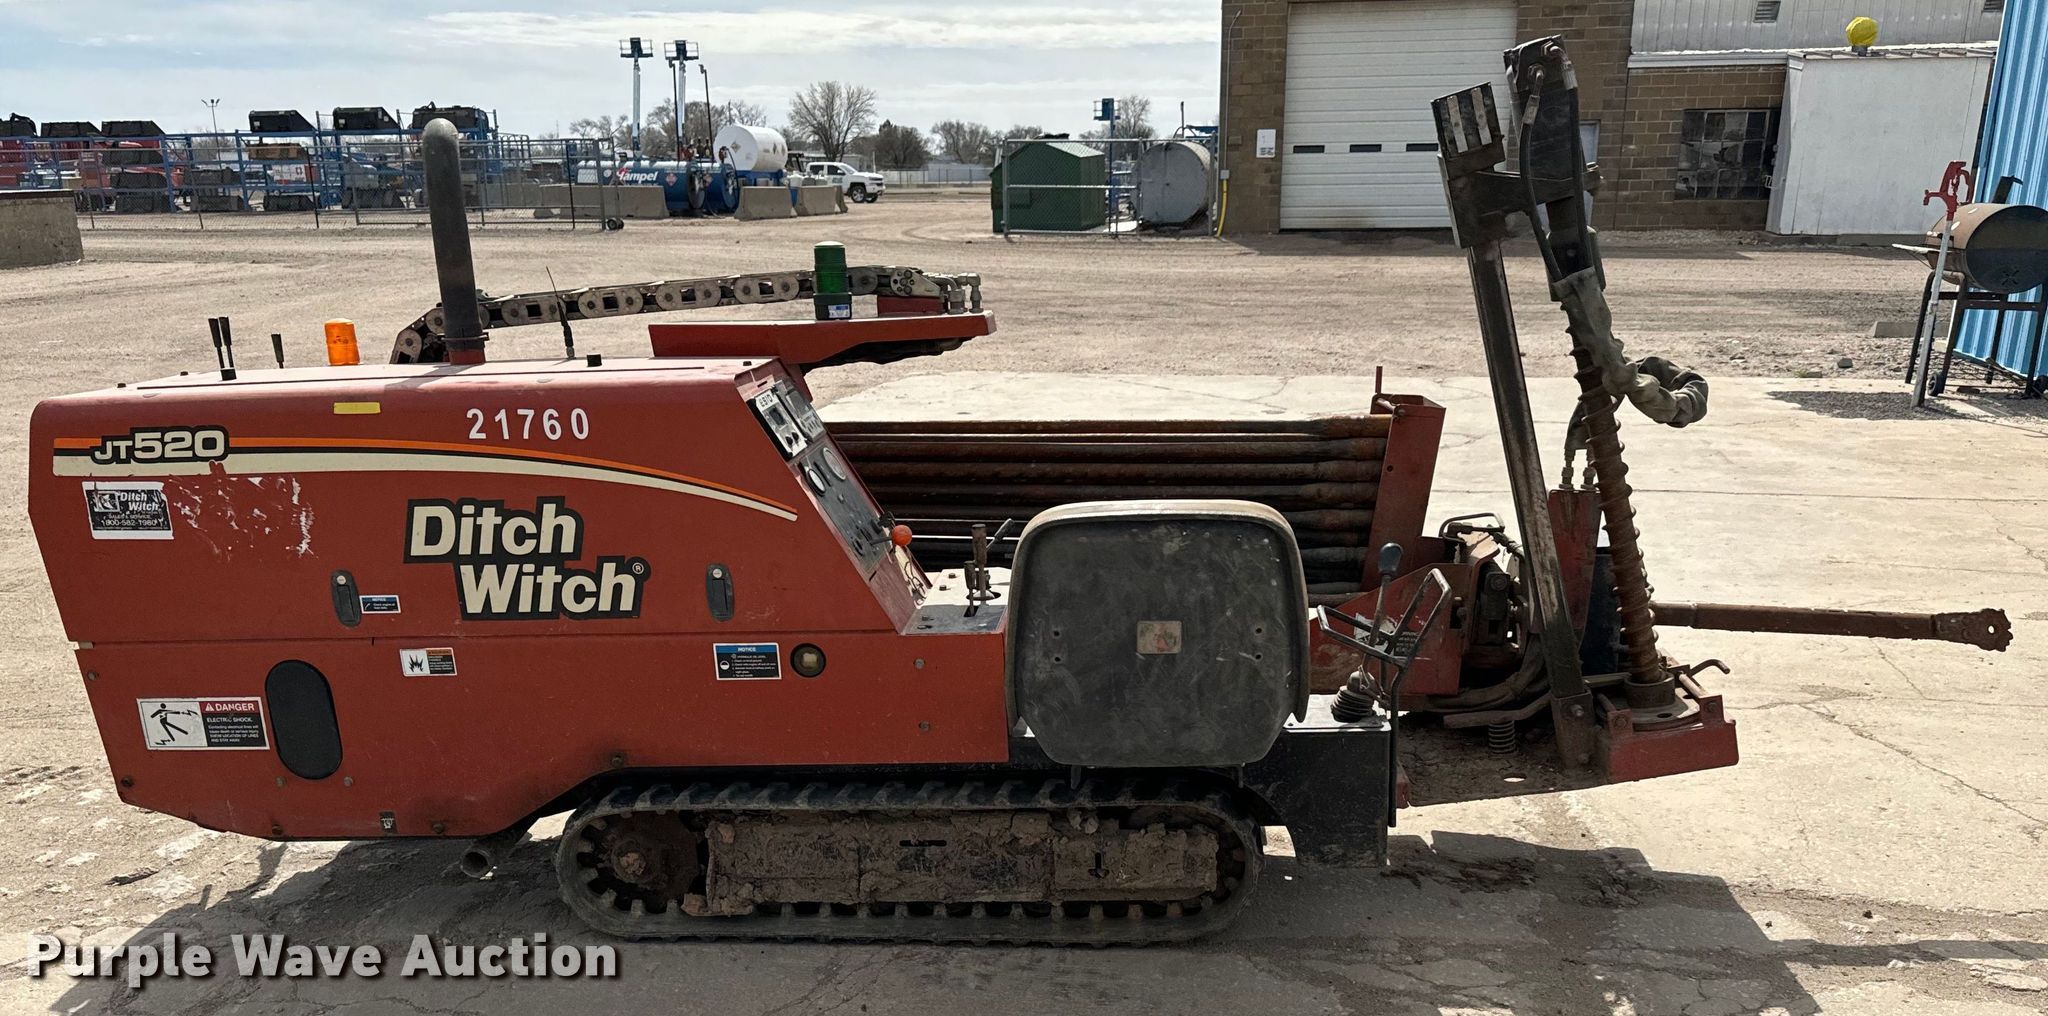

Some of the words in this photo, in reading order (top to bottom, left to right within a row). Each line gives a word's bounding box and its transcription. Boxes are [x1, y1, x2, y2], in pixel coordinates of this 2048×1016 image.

[466, 408, 589, 440] 21760
[94, 430, 225, 460] JT520
[120, 492, 147, 501] Ditch
[128, 501, 158, 511] Witch
[410, 503, 577, 556] Ditch
[215, 703, 255, 711] DANGER
